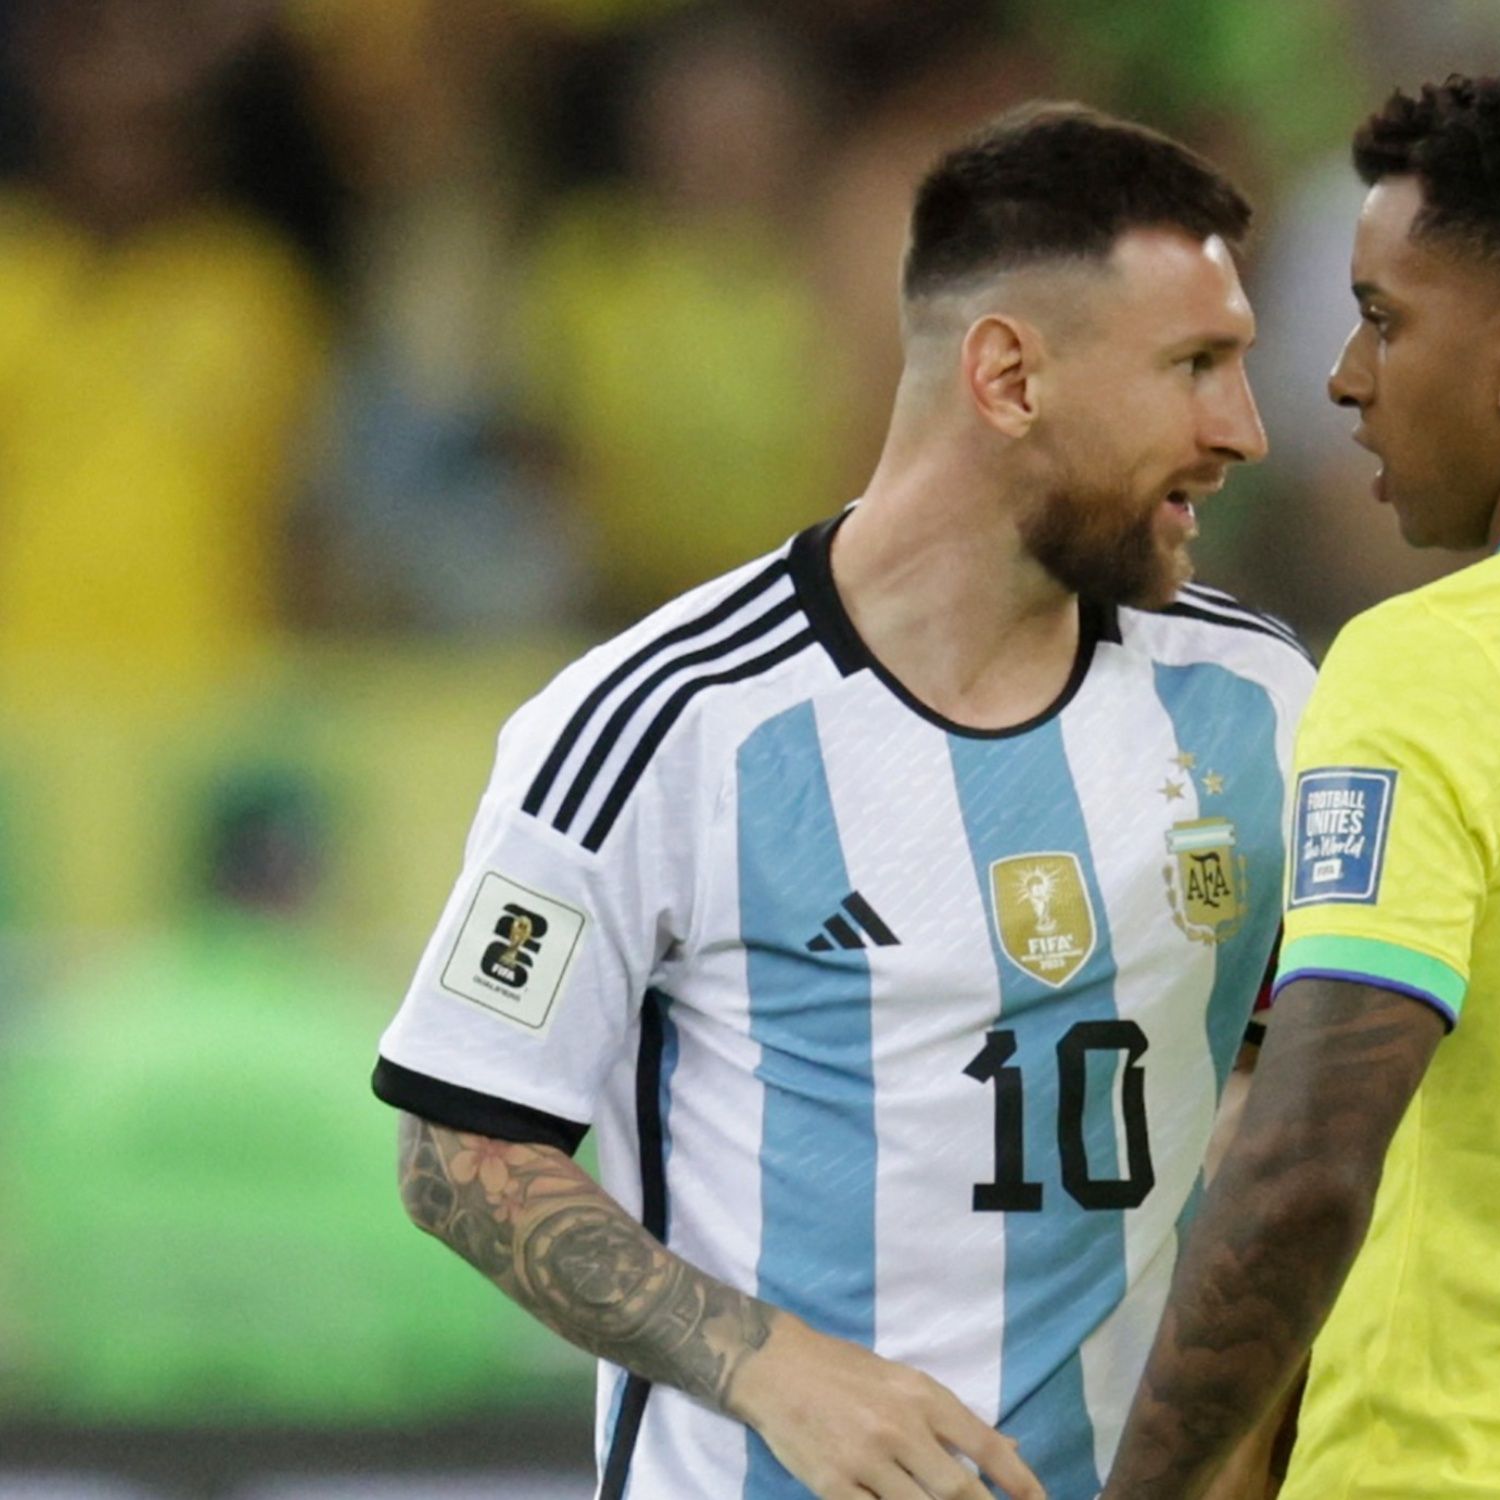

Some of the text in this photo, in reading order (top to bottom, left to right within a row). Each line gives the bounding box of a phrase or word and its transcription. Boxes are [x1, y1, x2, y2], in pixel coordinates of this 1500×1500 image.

[1307, 789, 1365, 811] FOOTBALL
[1306, 808, 1365, 837] UNITES
[1320, 834, 1366, 859] World
[1187, 851, 1231, 908] AFA
[1027, 935, 1069, 955] FIFA
[491, 961, 516, 983] FIFA
[962, 1019, 1156, 1213] 10
